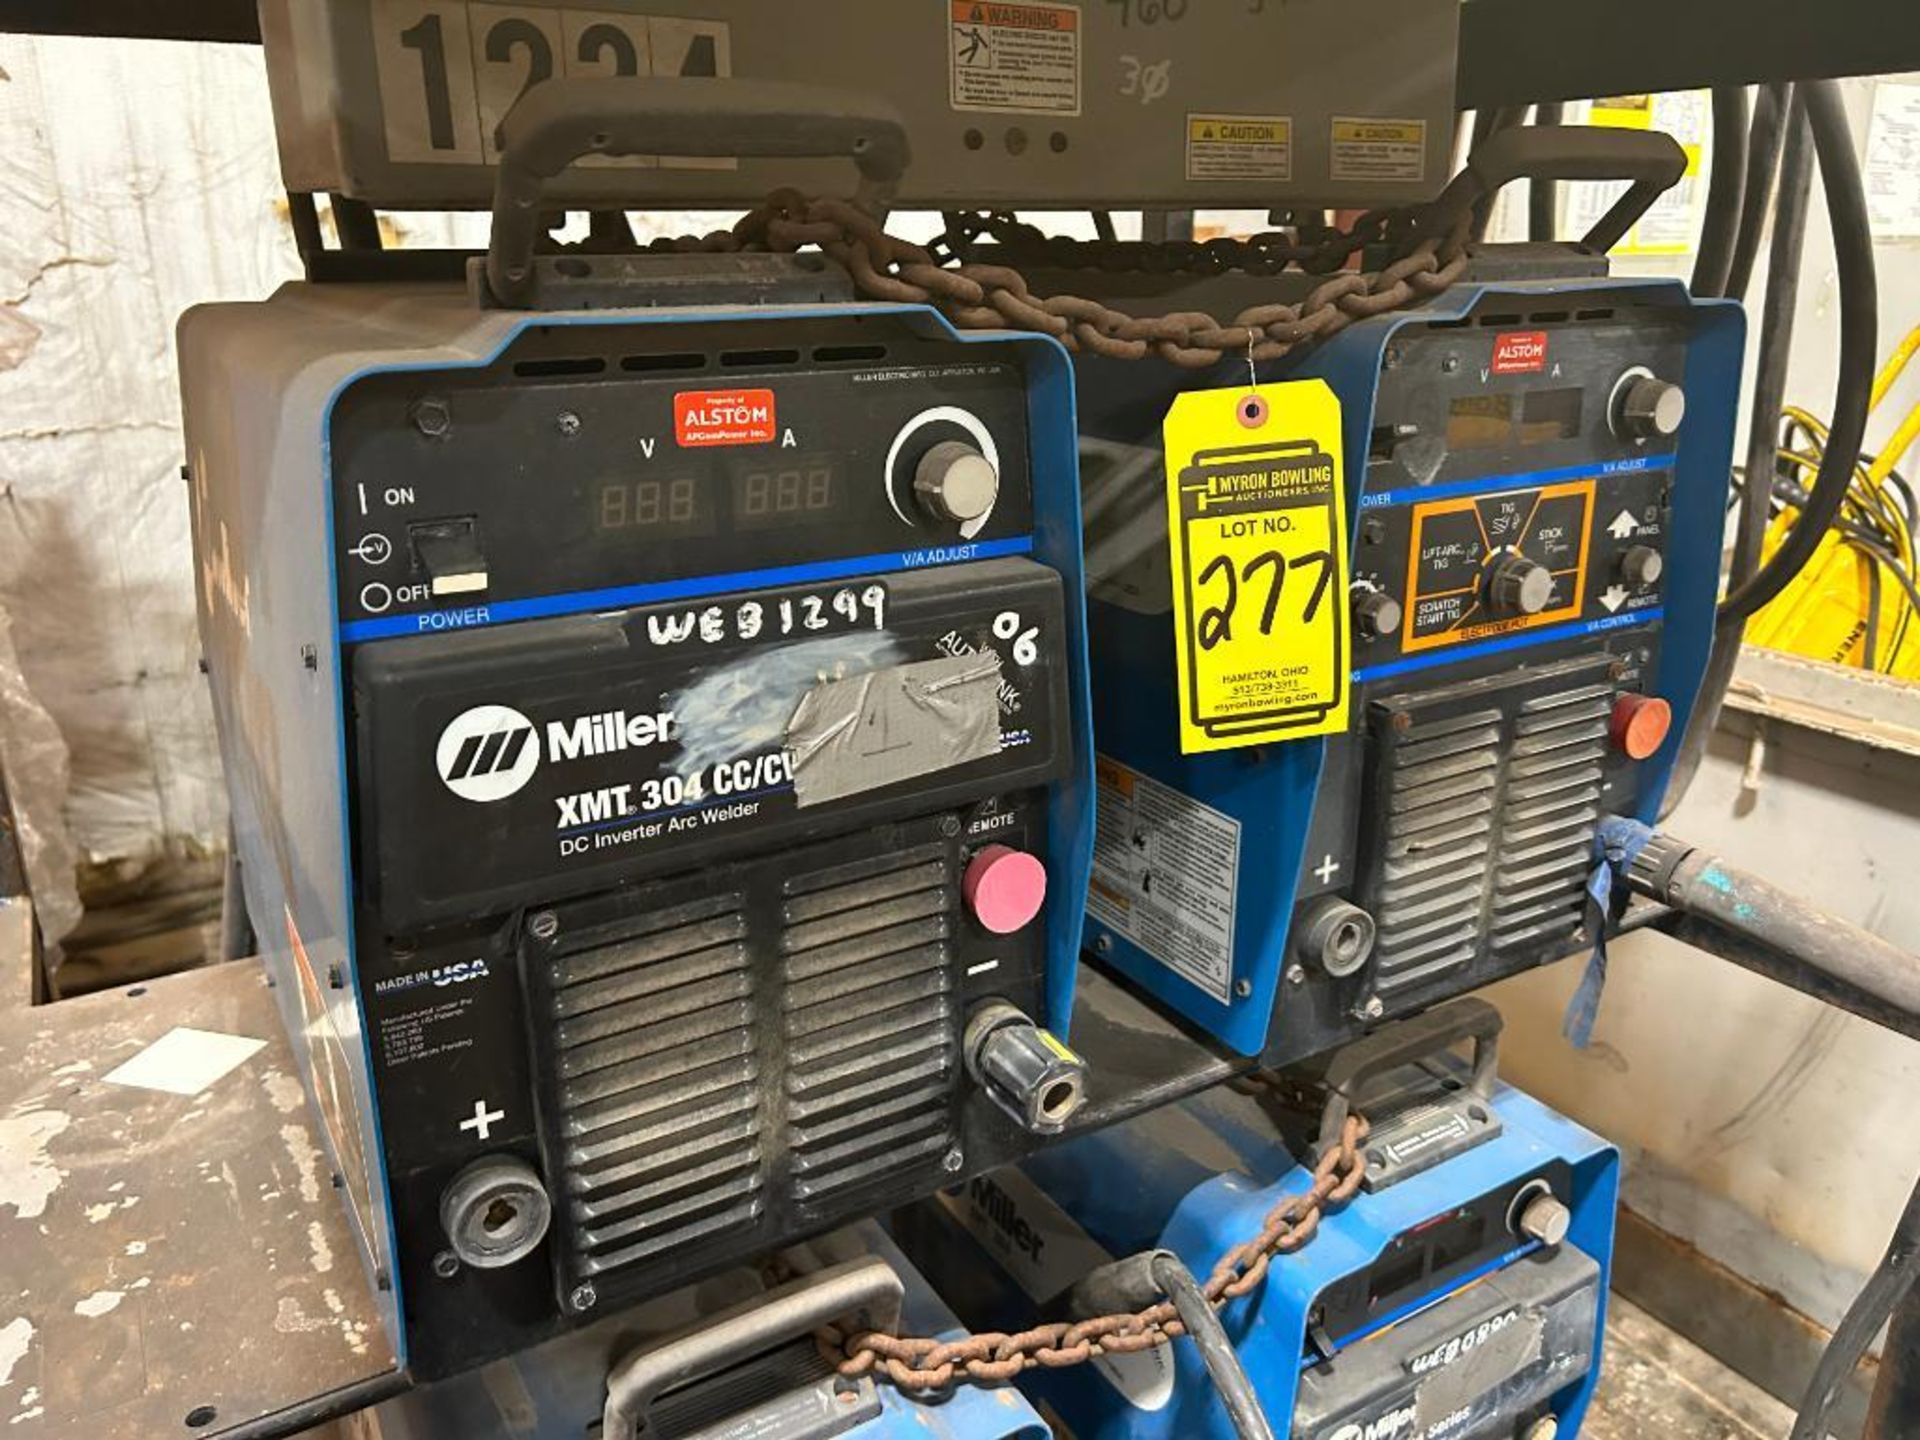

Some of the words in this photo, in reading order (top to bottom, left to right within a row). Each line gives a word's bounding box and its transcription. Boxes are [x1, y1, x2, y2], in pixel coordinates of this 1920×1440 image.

[987, 6, 1058, 29] WARNING
[1220, 125, 1274, 140] CAUTION
[1498, 343, 1543, 359] ALSTOM
[1480, 368, 1489, 384] V
[1551, 362, 1561, 379] A
[684, 407, 768, 427] ALSTOM
[640, 438, 655, 459] V
[781, 428, 797, 448] A
[1219, 474, 1267, 493] MYRON
[1271, 466, 1331, 488] BOWLING
[384, 488, 415, 505] ON
[1361, 491, 1391, 507] OWER
[1220, 520, 1258, 538] LOT
[1264, 516, 1296, 533] NO.
[902, 552, 924, 568] V/A
[926, 545, 978, 563] ADJUST
[1199, 550, 1334, 650] 277
[418, 607, 490, 630] POWER
[547, 711, 676, 762] Miller
[642, 770, 701, 809] 304
[560, 838, 590, 856] DC
[595, 824, 663, 849] Inverter
[668, 816, 697, 832] Arc
[702, 802, 760, 825] Welder
[375, 976, 414, 992] MADE
[416, 970, 429, 982] IN
[431, 958, 490, 988] USA
[969, 1176, 1045, 1263] Miller
